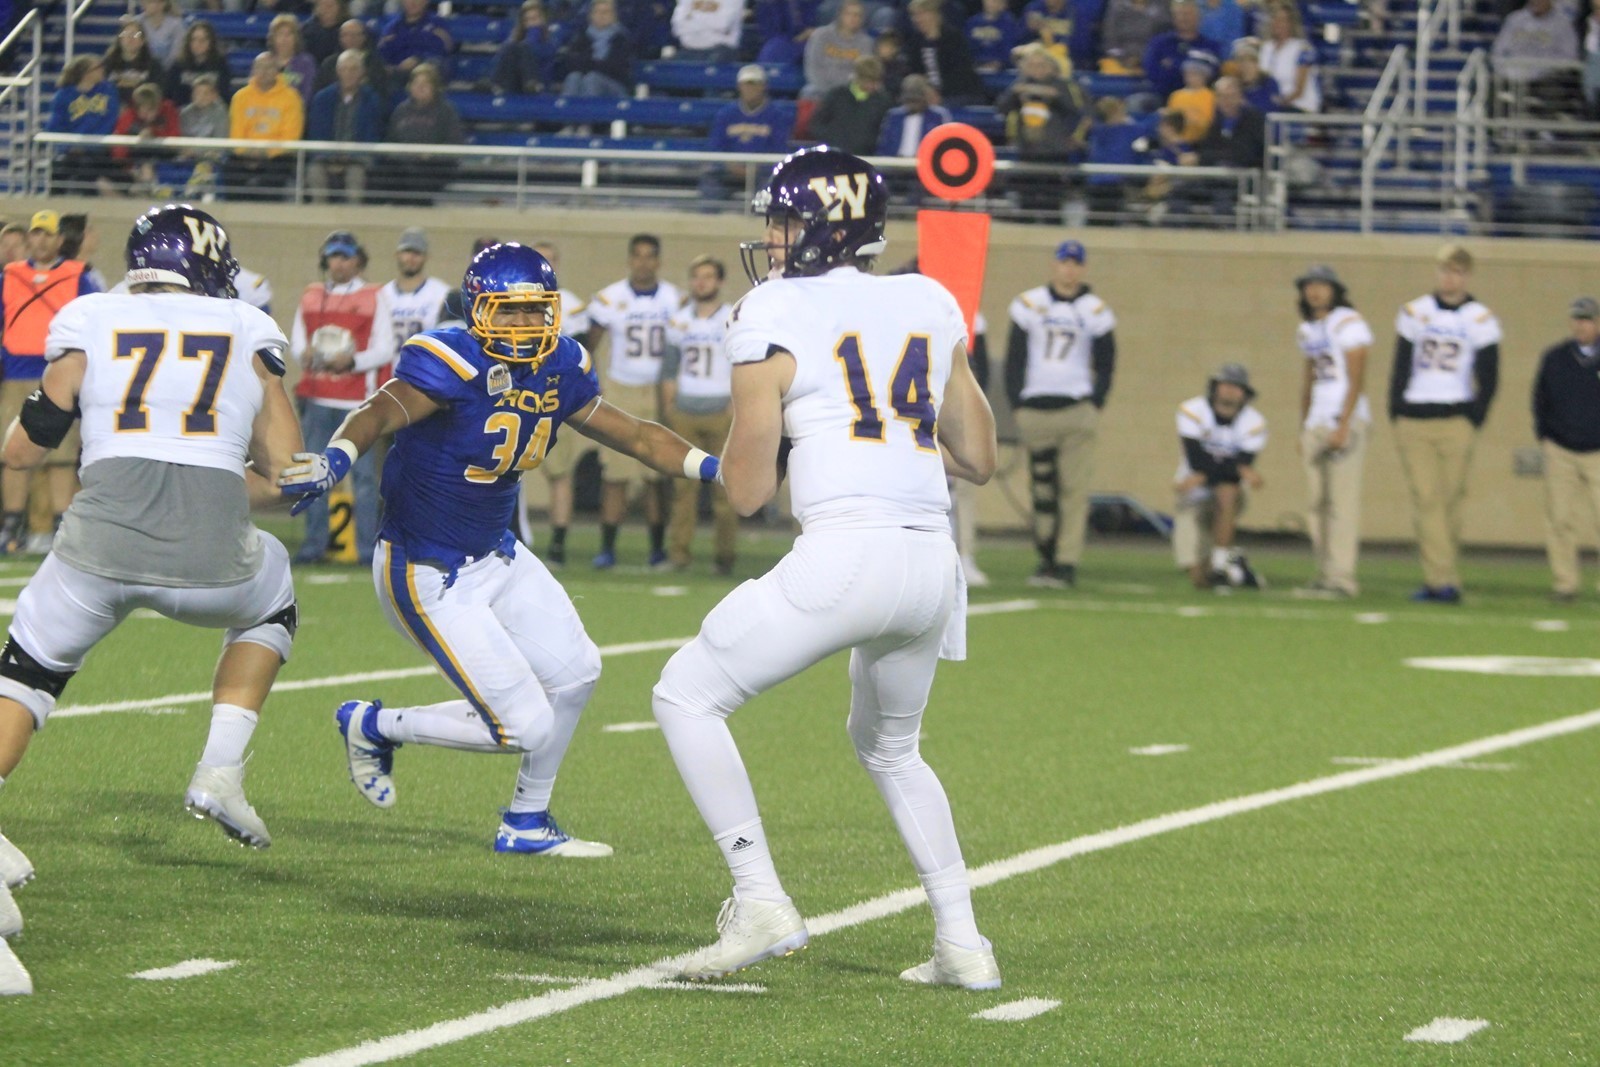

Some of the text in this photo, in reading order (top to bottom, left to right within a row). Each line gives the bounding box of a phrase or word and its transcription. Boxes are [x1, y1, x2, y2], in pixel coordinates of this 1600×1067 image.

[810, 173, 869, 221] W
[183, 215, 228, 262] W
[626, 324, 665, 357] 50
[685, 346, 713, 378] 21
[1044, 329, 1076, 361] 17
[112, 329, 234, 437] 77
[832, 331, 938, 454] 14
[464, 411, 552, 483] 34
[328, 502, 352, 552] 2
[730, 840, 754, 852] adidas
